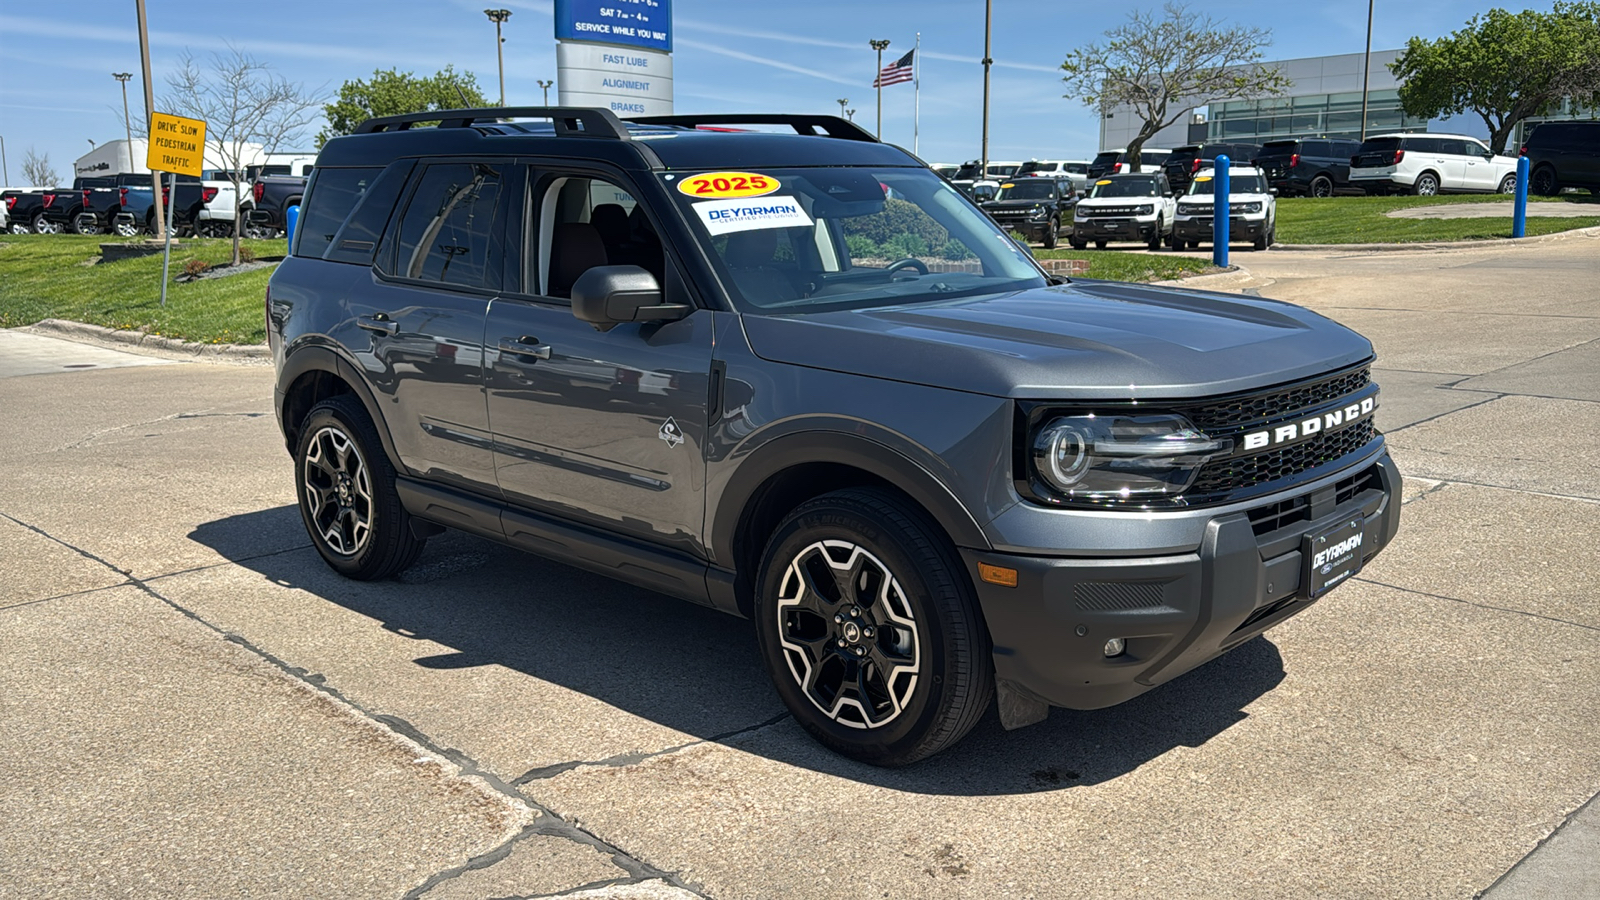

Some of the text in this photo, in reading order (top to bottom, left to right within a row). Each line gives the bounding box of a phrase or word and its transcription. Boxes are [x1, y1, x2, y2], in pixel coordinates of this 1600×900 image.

[600, 7, 615, 17] SAT
[575, 22, 666, 41] SERVICE WHILE YOU WAIT
[603, 54, 648, 68] FAST LUBE
[602, 78, 650, 91] ALIGNMENT
[611, 102, 645, 113] BRAKES
[157, 121, 198, 136] DRIVE SLOW
[156, 137, 196, 152] PEDESTRIAN
[162, 154, 189, 168] TRAFFIC
[692, 176, 768, 194] 2025
[708, 205, 796, 220] DEYARMAN
[719, 216, 757, 224] CERTIFIED
[1244, 396, 1374, 450] BRONCO
[1312, 531, 1363, 570] DEYARMAN
